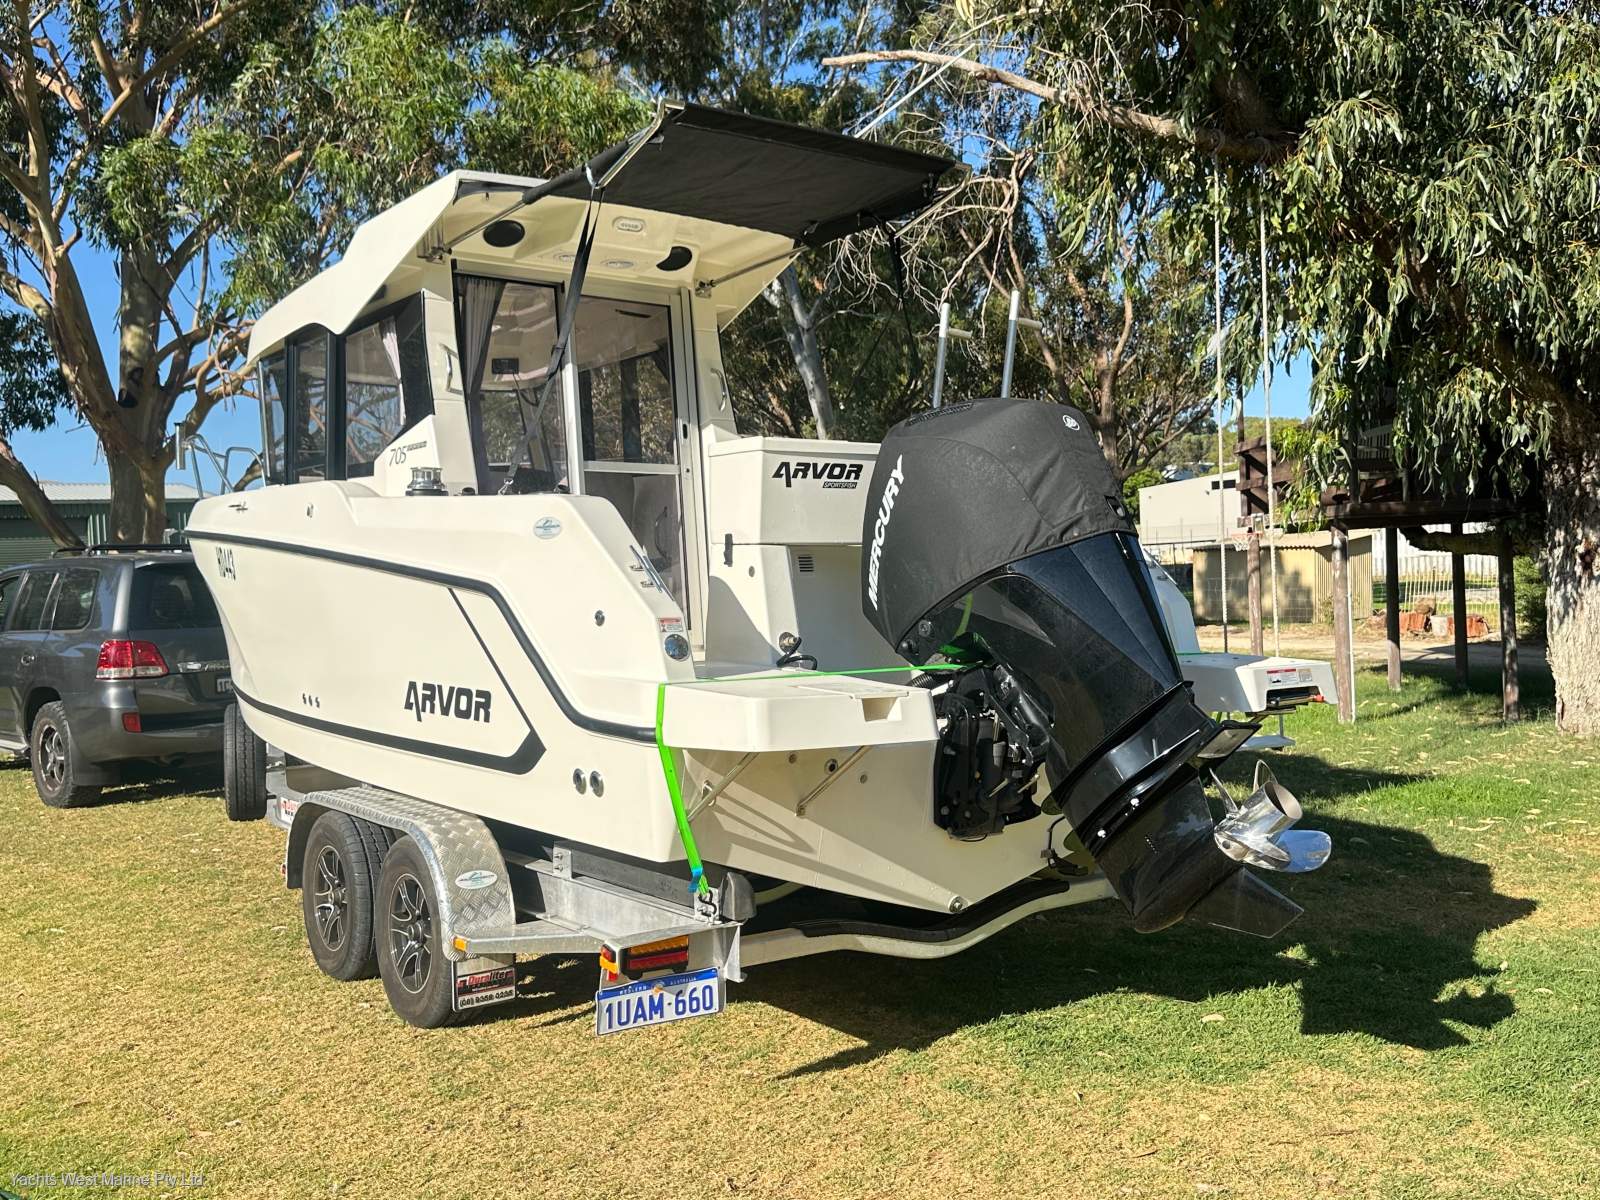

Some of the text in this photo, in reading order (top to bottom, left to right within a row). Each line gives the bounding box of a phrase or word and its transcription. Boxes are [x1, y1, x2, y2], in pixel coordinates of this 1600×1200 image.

[389, 446, 407, 467] 705
[772, 461, 864, 488] ARVOR
[868, 454, 905, 611] MERCURY
[404, 681, 492, 722] ARVOR
